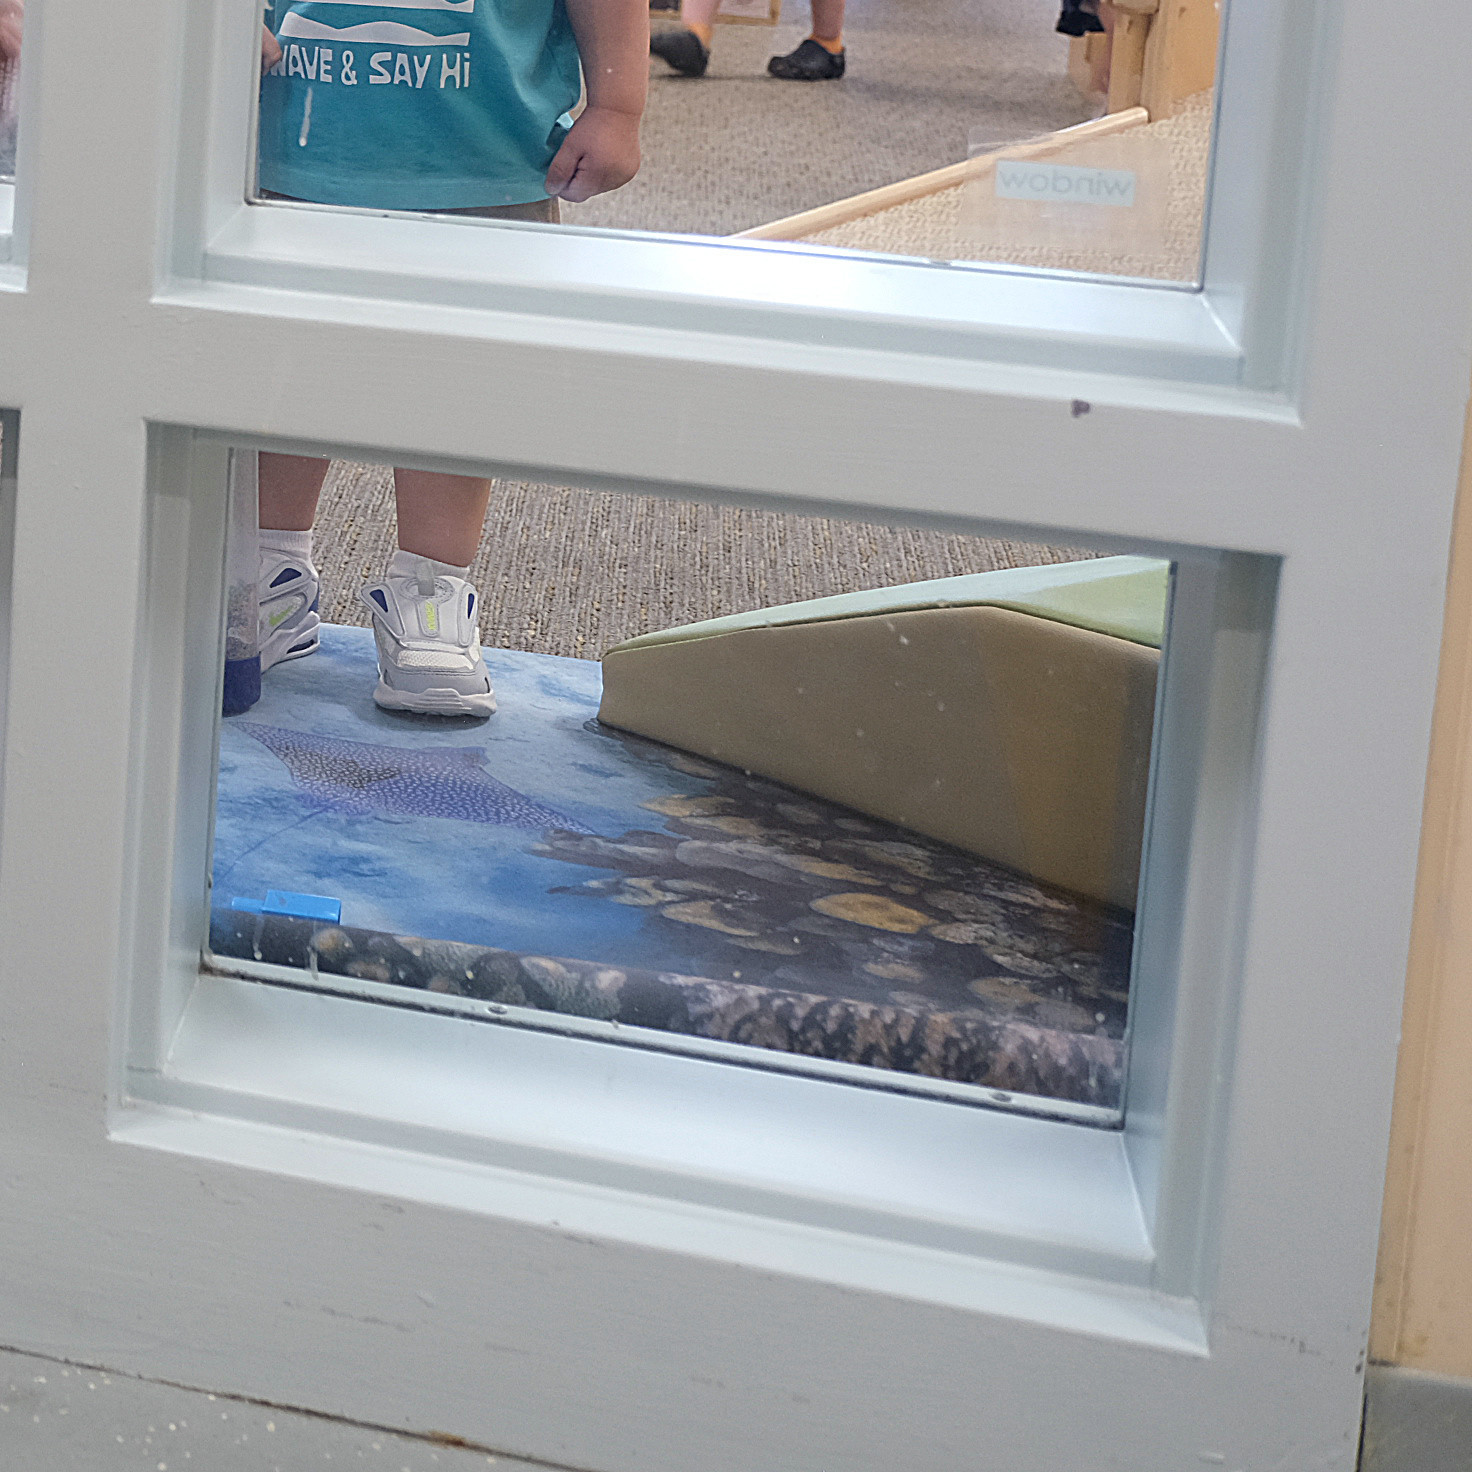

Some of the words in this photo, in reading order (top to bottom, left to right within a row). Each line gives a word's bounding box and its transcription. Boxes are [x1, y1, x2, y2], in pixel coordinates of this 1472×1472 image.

[341, 50, 358, 86] &
[369, 51, 432, 89] SAY
[439, 52, 470, 89] Hi
